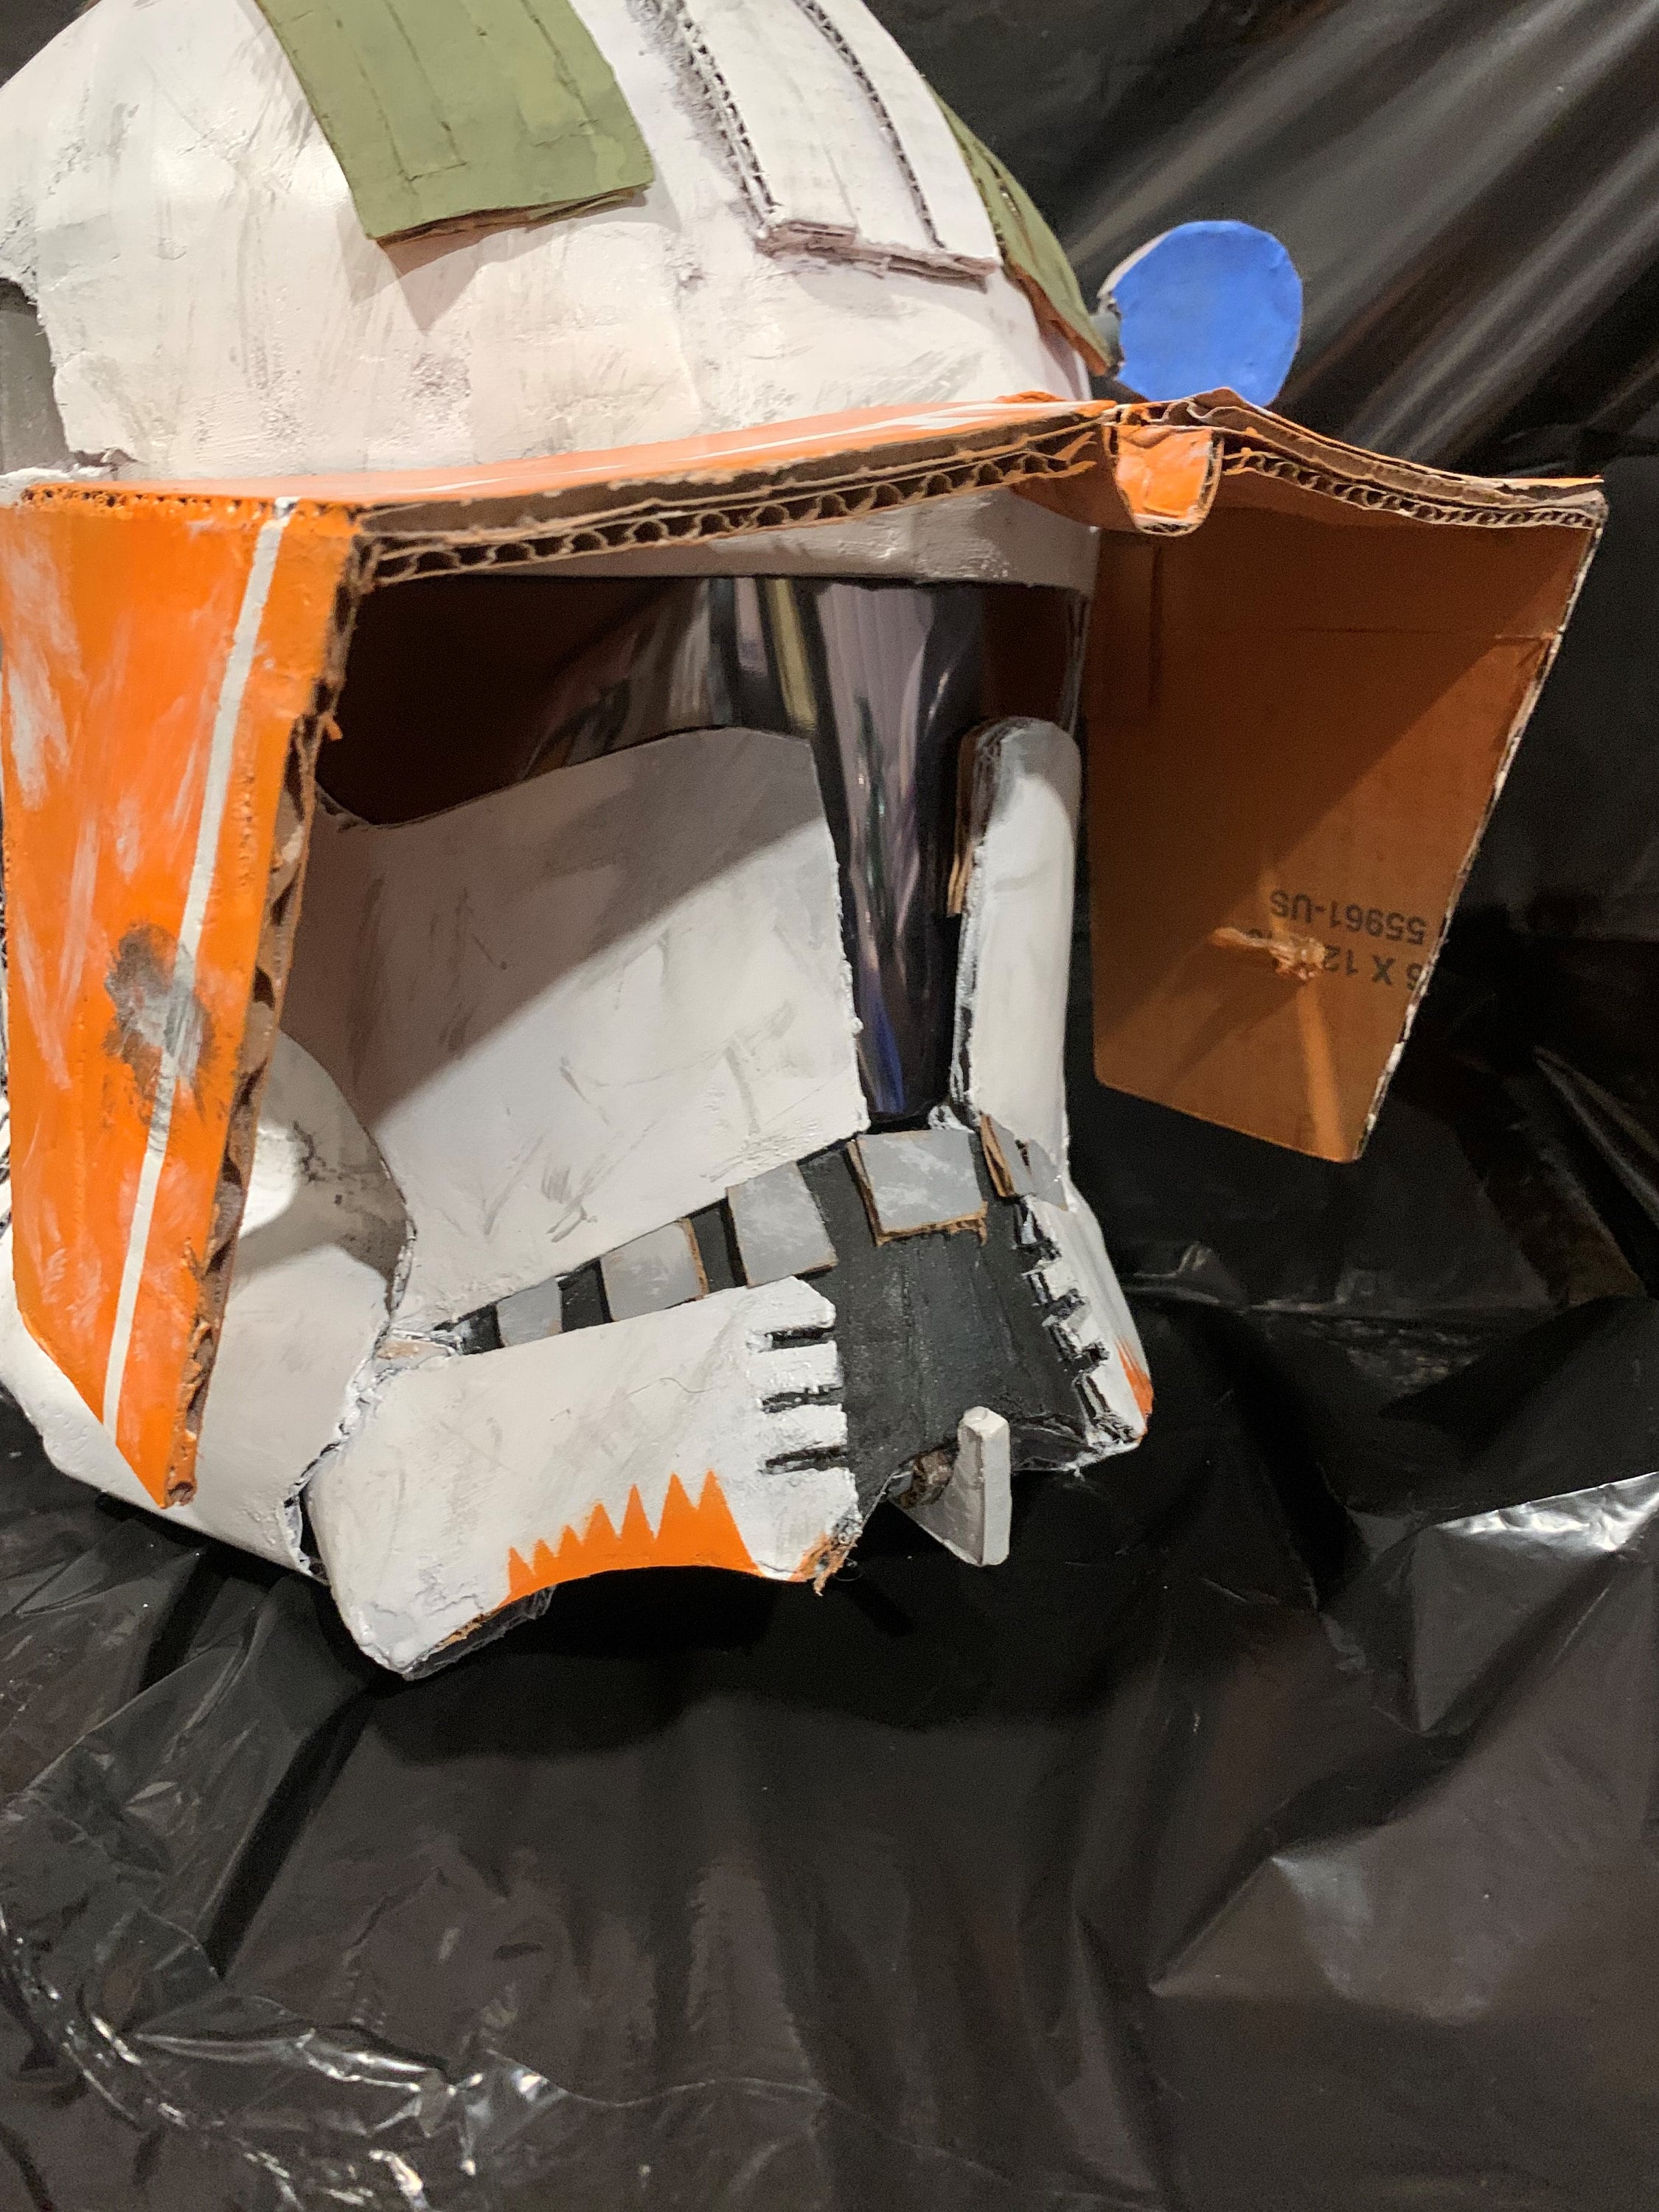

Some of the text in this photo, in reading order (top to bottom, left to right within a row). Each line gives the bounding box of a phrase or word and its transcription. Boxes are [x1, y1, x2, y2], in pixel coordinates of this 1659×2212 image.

[1270, 890, 1427, 945] 55961-US
[1324, 946, 1357, 977] 12
[1372, 954, 1395, 986] X
